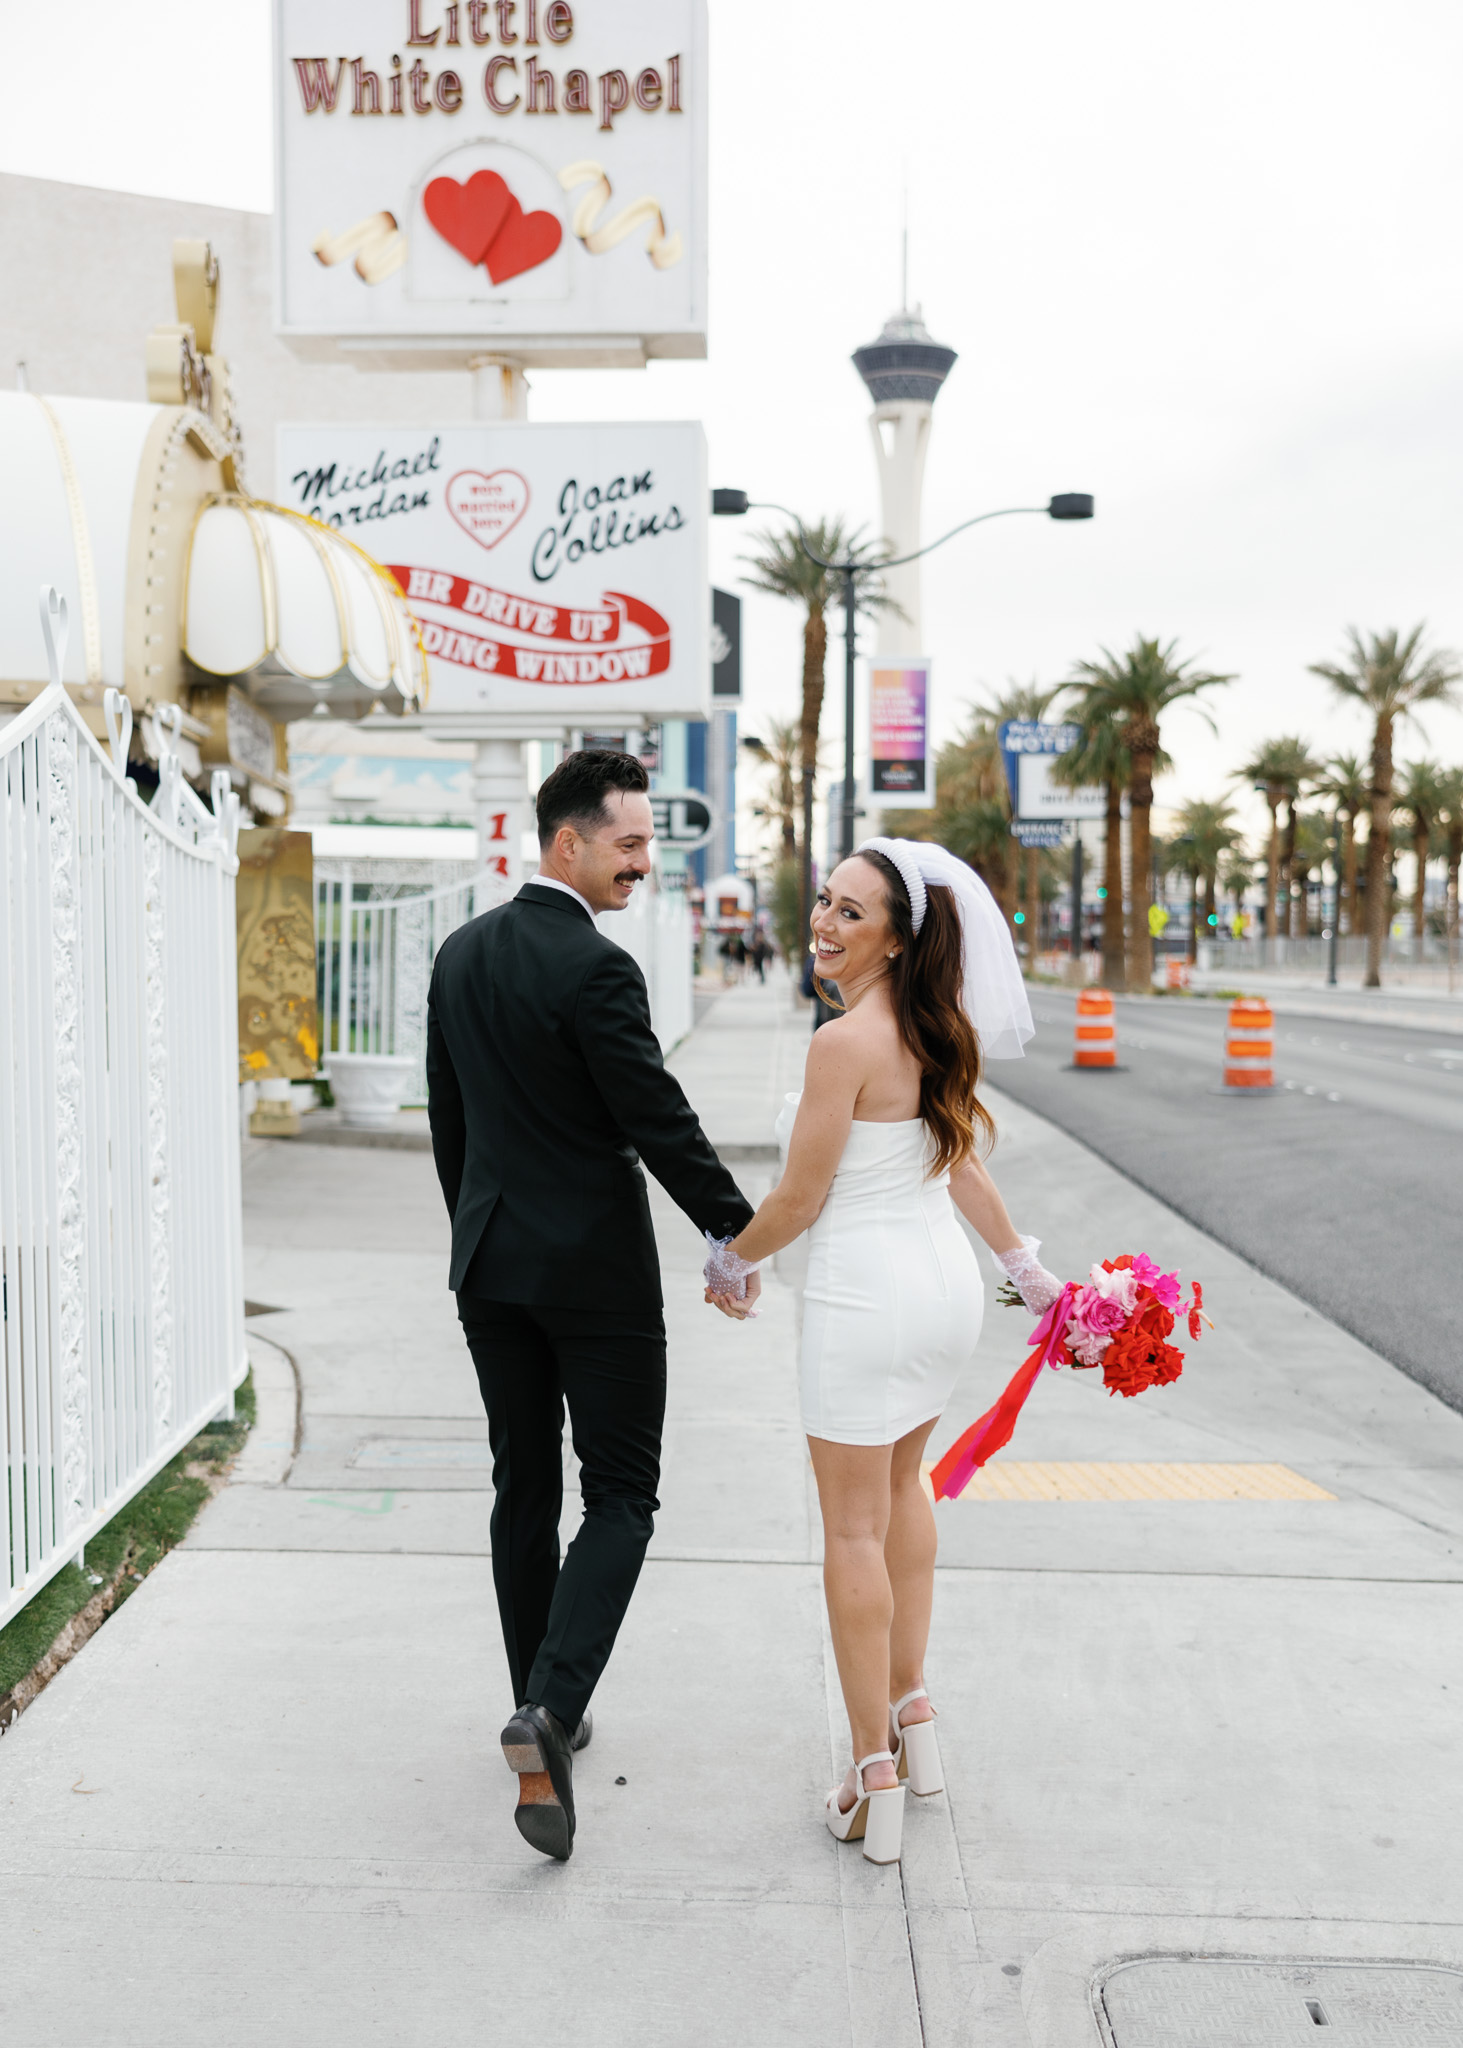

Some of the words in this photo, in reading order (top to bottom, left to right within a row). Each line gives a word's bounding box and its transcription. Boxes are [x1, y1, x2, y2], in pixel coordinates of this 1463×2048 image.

[406, 0, 574, 46] Little
[292, 53, 463, 116] White
[482, 54, 683, 131] Chapel
[292, 436, 440, 501] Michael
[558, 470, 653, 537] Joan
[531, 505, 685, 581] Collins
[406, 568, 454, 603] HR
[460, 583, 558, 636] DRIVE
[569, 610, 613, 642] UP
[410, 621, 500, 672] DING
[514, 646, 652, 683] WINDOW
